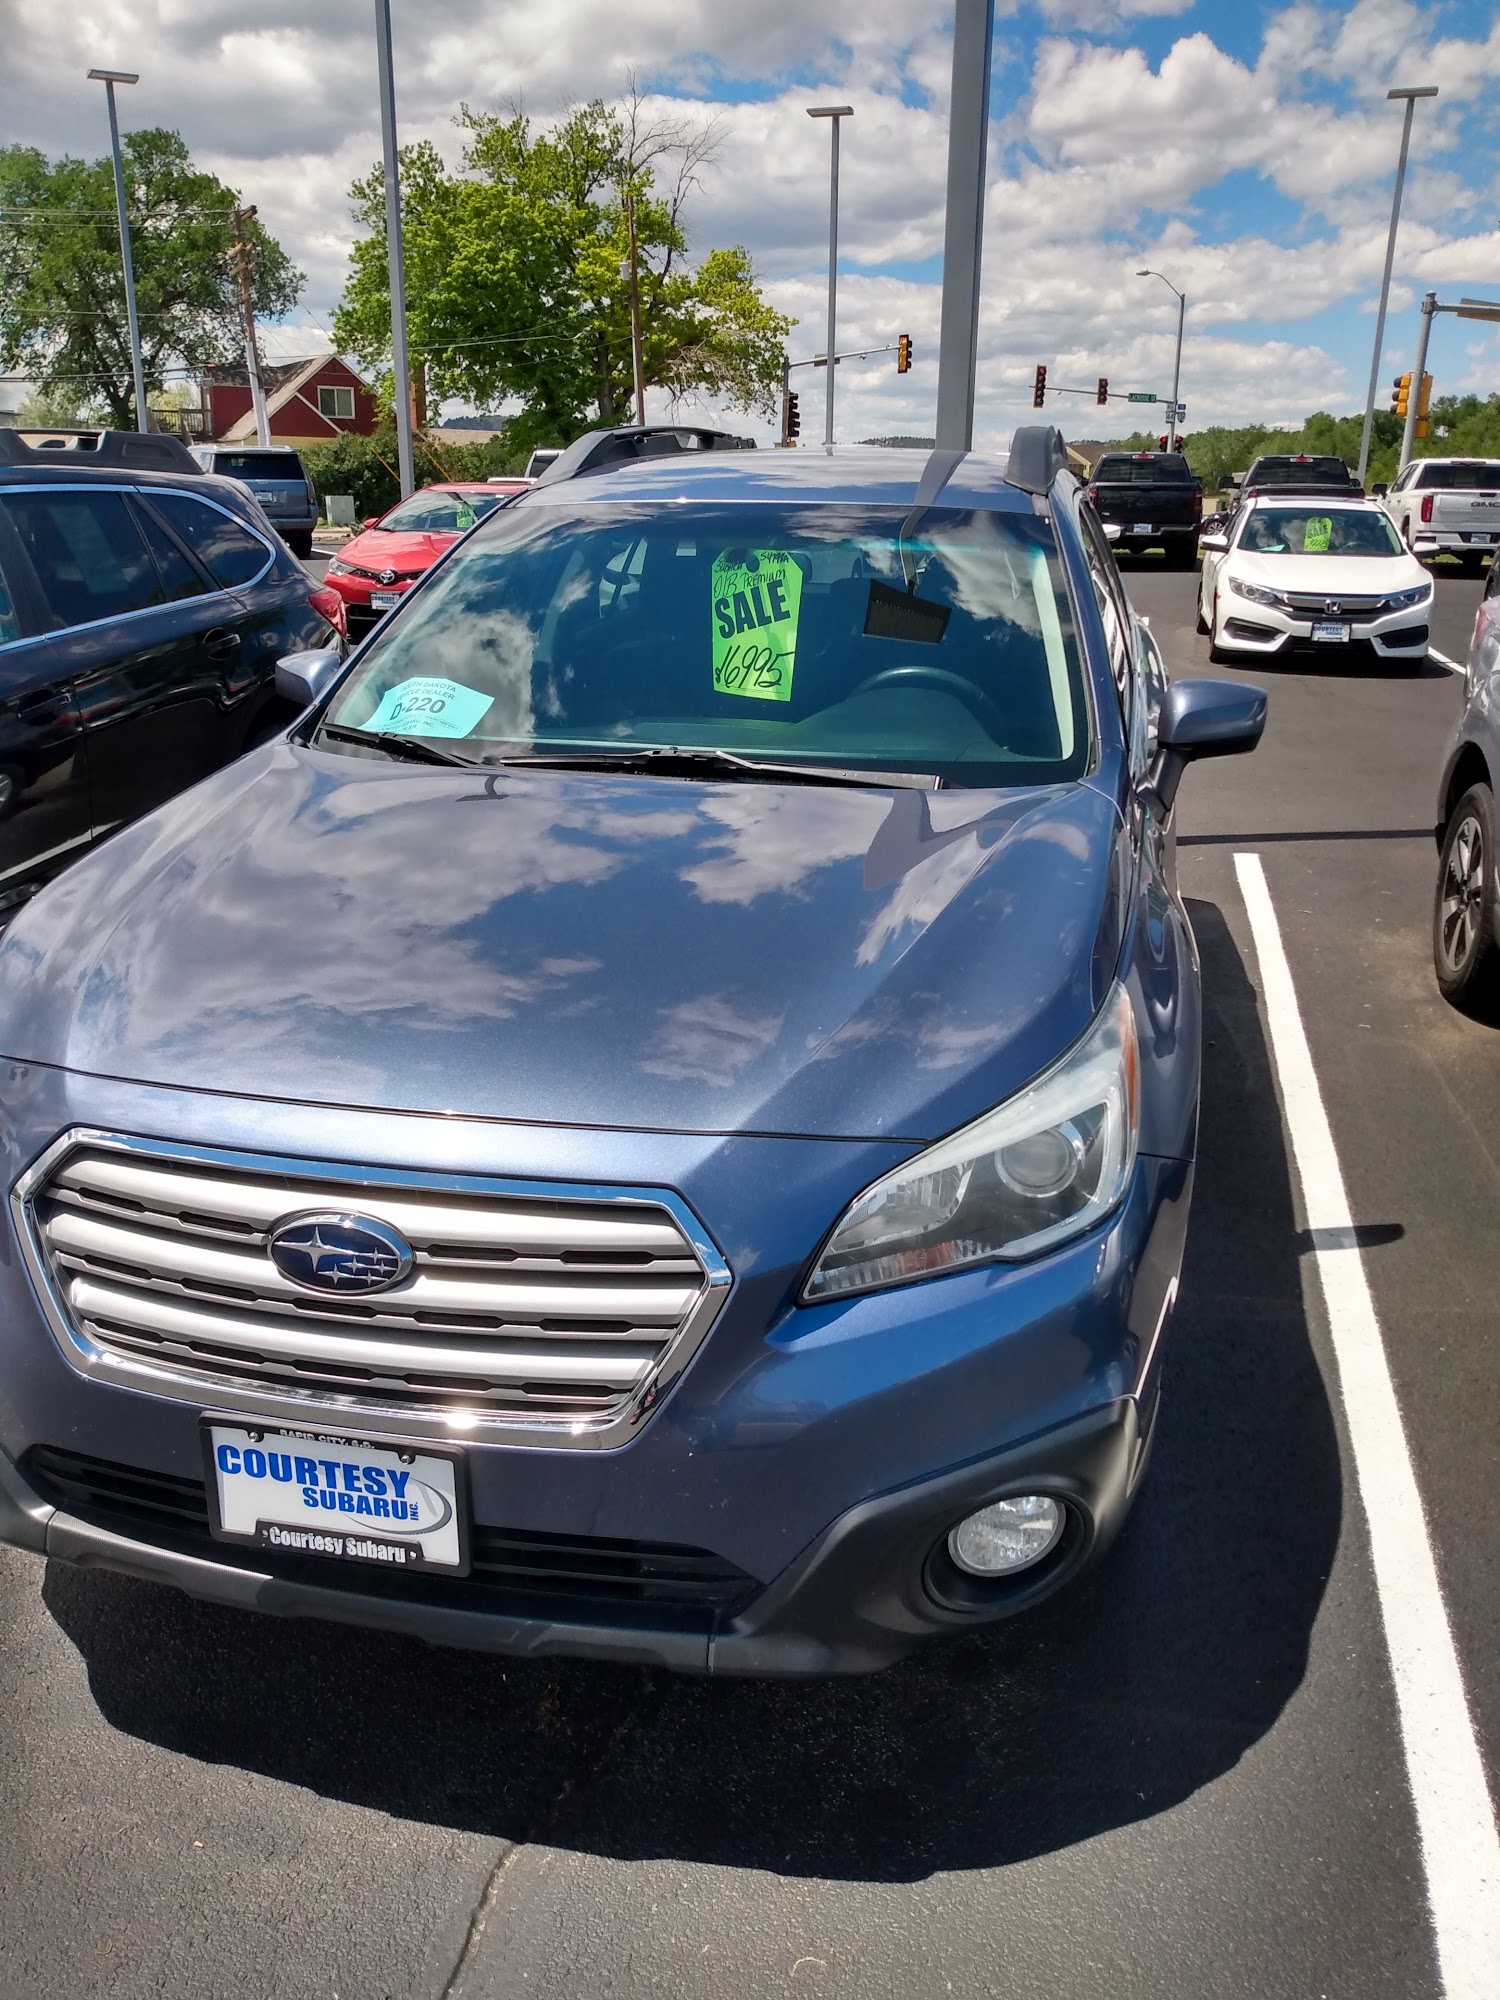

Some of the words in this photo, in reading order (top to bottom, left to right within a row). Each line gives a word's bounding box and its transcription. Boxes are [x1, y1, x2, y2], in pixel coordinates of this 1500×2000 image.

[1307, 524, 1328, 539] SALE
[741, 568, 786, 589] PREMIUM
[714, 579, 790, 639] SALE
[421, 688, 456, 700] DEALER
[423, 681, 456, 693] DAKOTA
[389, 696, 446, 721] D-220
[217, 1444, 410, 1498] COURTESY
[302, 1487, 408, 1521] SUBARU
[409, 1501, 419, 1521] INC.
[270, 1526, 344, 1556] Courtesy
[346, 1537, 406, 1564] Subaru
